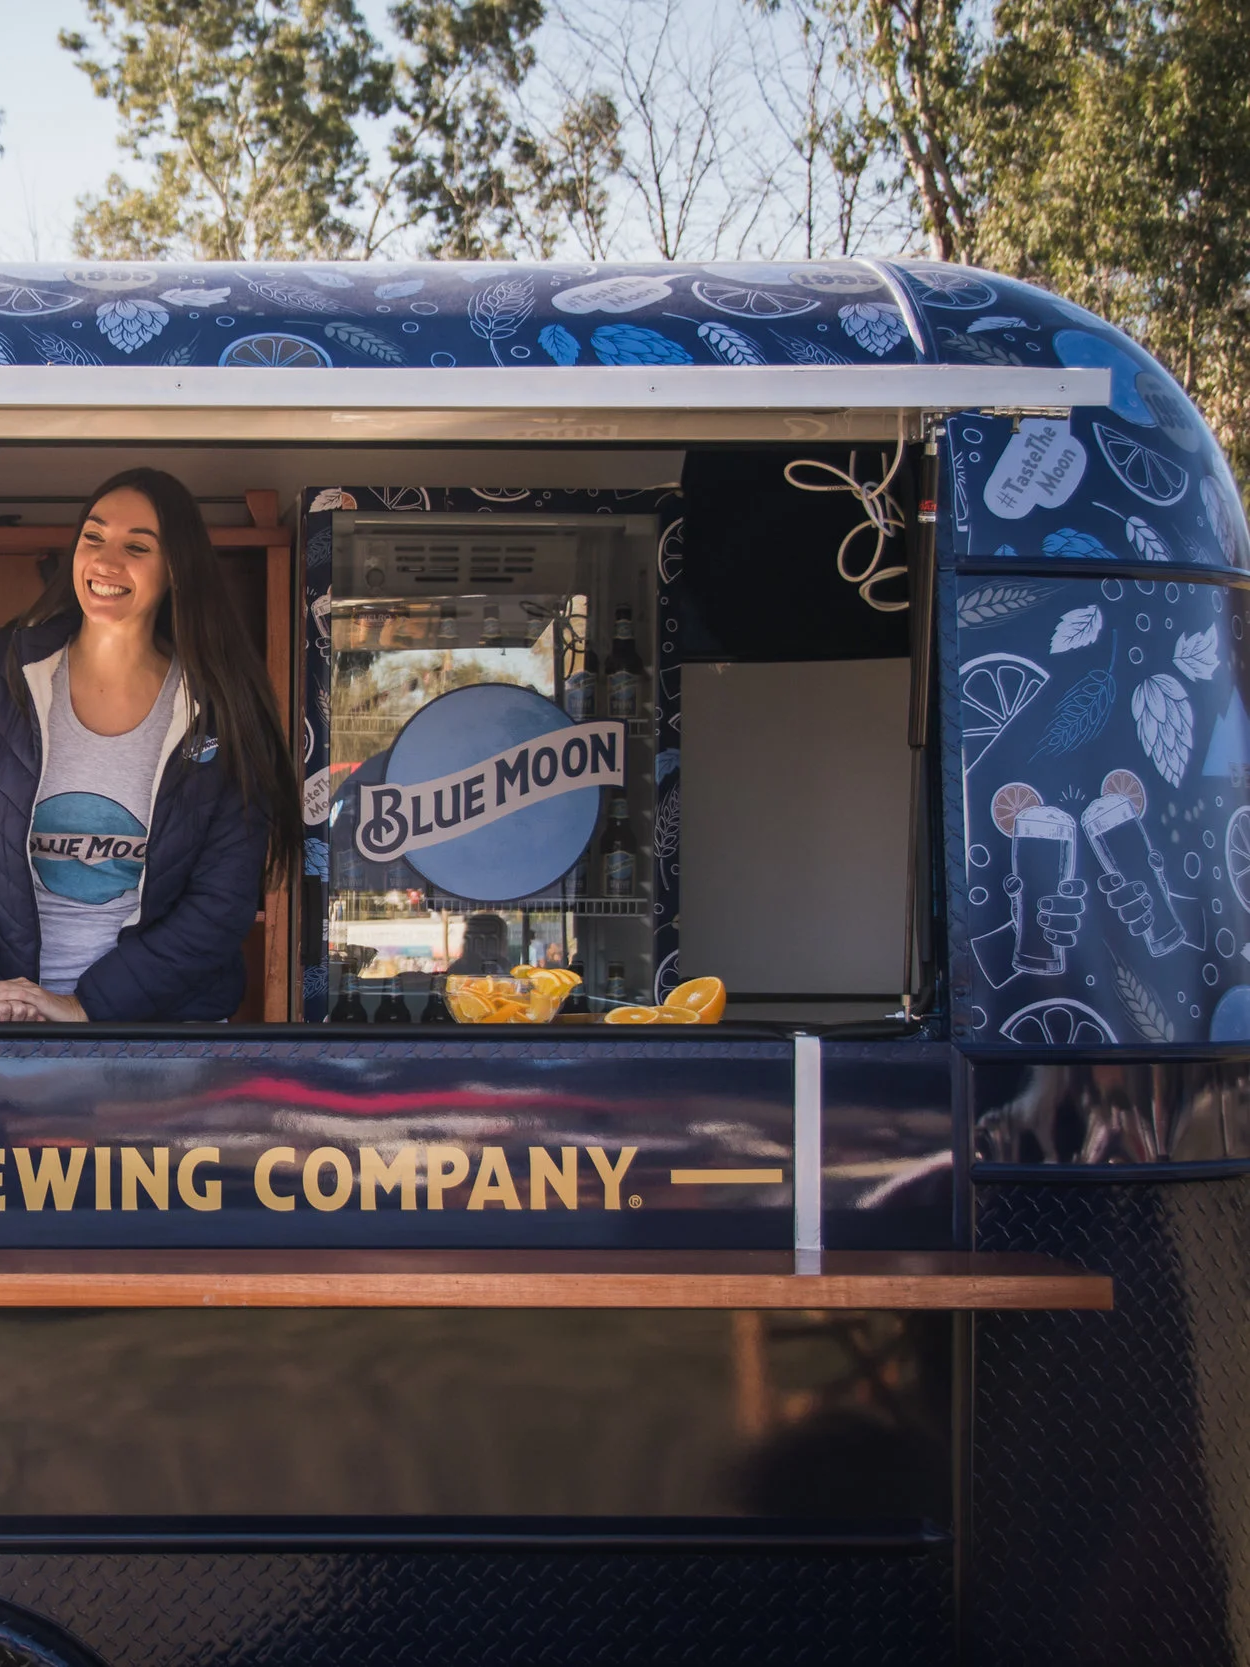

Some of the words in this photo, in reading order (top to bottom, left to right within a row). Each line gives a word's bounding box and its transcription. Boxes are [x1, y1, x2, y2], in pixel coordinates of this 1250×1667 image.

[996, 424, 1058, 509] #TasteThe
[1035, 448, 1078, 497] Moon
[361, 772, 486, 855] BLUE
[494, 731, 618, 808] MOON
[30, 837, 84, 858] LUE
